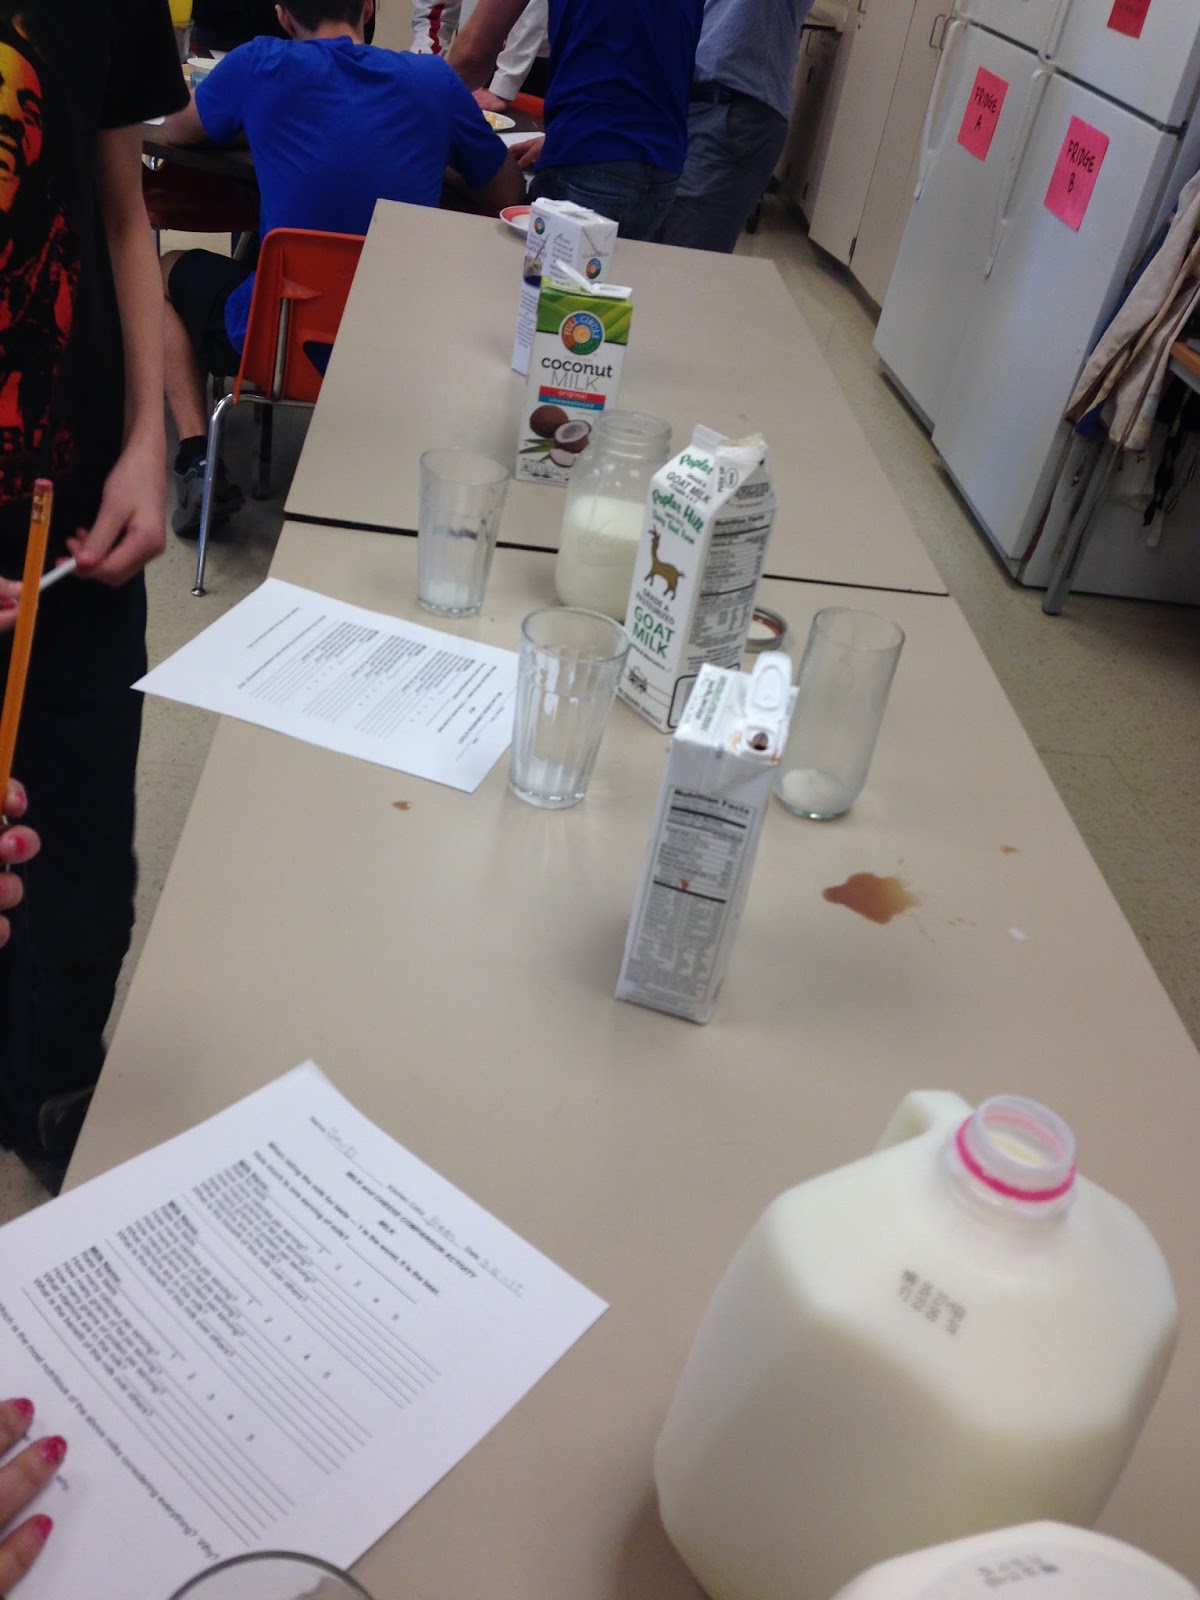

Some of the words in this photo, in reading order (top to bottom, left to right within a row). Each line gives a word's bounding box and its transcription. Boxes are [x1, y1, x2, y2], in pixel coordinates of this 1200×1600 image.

[975, 86, 998, 113] FRIDGE
[975, 113, 983, 130] A
[1066, 139, 1096, 173] FRIDGE
[1067, 172, 1076, 193] B
[541, 357, 613, 378] coconut
[551, 370, 599, 392] MILK
[666, 472, 692, 489] GOAT
[689, 486, 712, 504] MILK
[633, 606, 676, 643] GOAT
[632, 621, 669, 659] MILK
